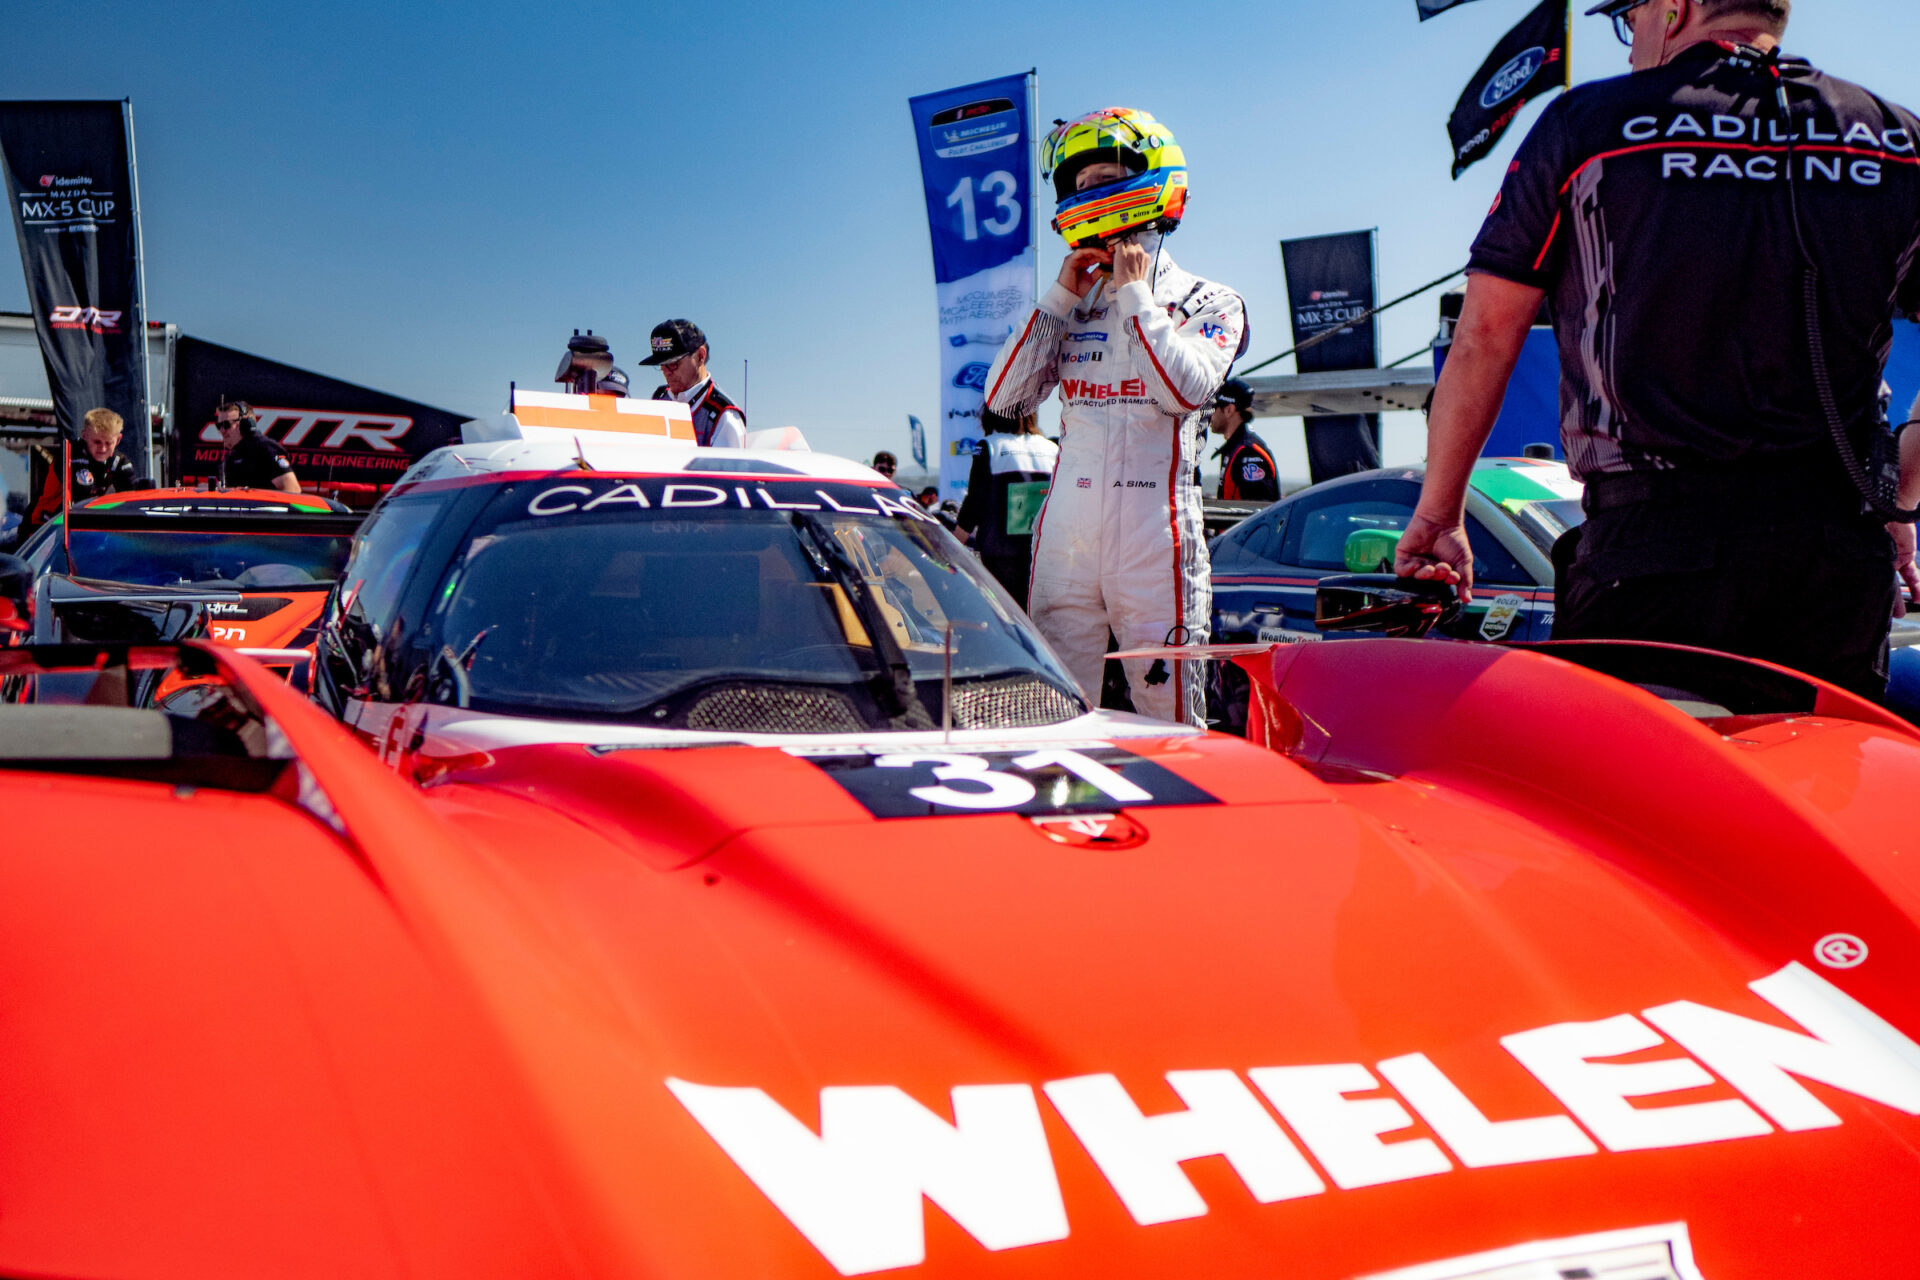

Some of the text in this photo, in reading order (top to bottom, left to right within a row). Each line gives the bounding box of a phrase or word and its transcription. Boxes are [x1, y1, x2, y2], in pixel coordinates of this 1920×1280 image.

[1493, 57, 1532, 99] Ford
[1621, 113, 1914, 152] CADILLAC
[1662, 152, 1882, 186] RACING
[22, 198, 115, 218] MX-5 CUP
[50, 188, 87, 198] MAZDA
[947, 170, 1022, 241] 13
[1335, 306, 1365, 320] CUP
[1061, 351, 1091, 364] Mobil
[311, 454, 410, 470] ENGINEERING
[1126, 480, 1157, 489] SIMS
[527, 483, 942, 526] CADILLAC
[874, 748, 1154, 809] 31
[663, 959, 1920, 1277] WHELEN
